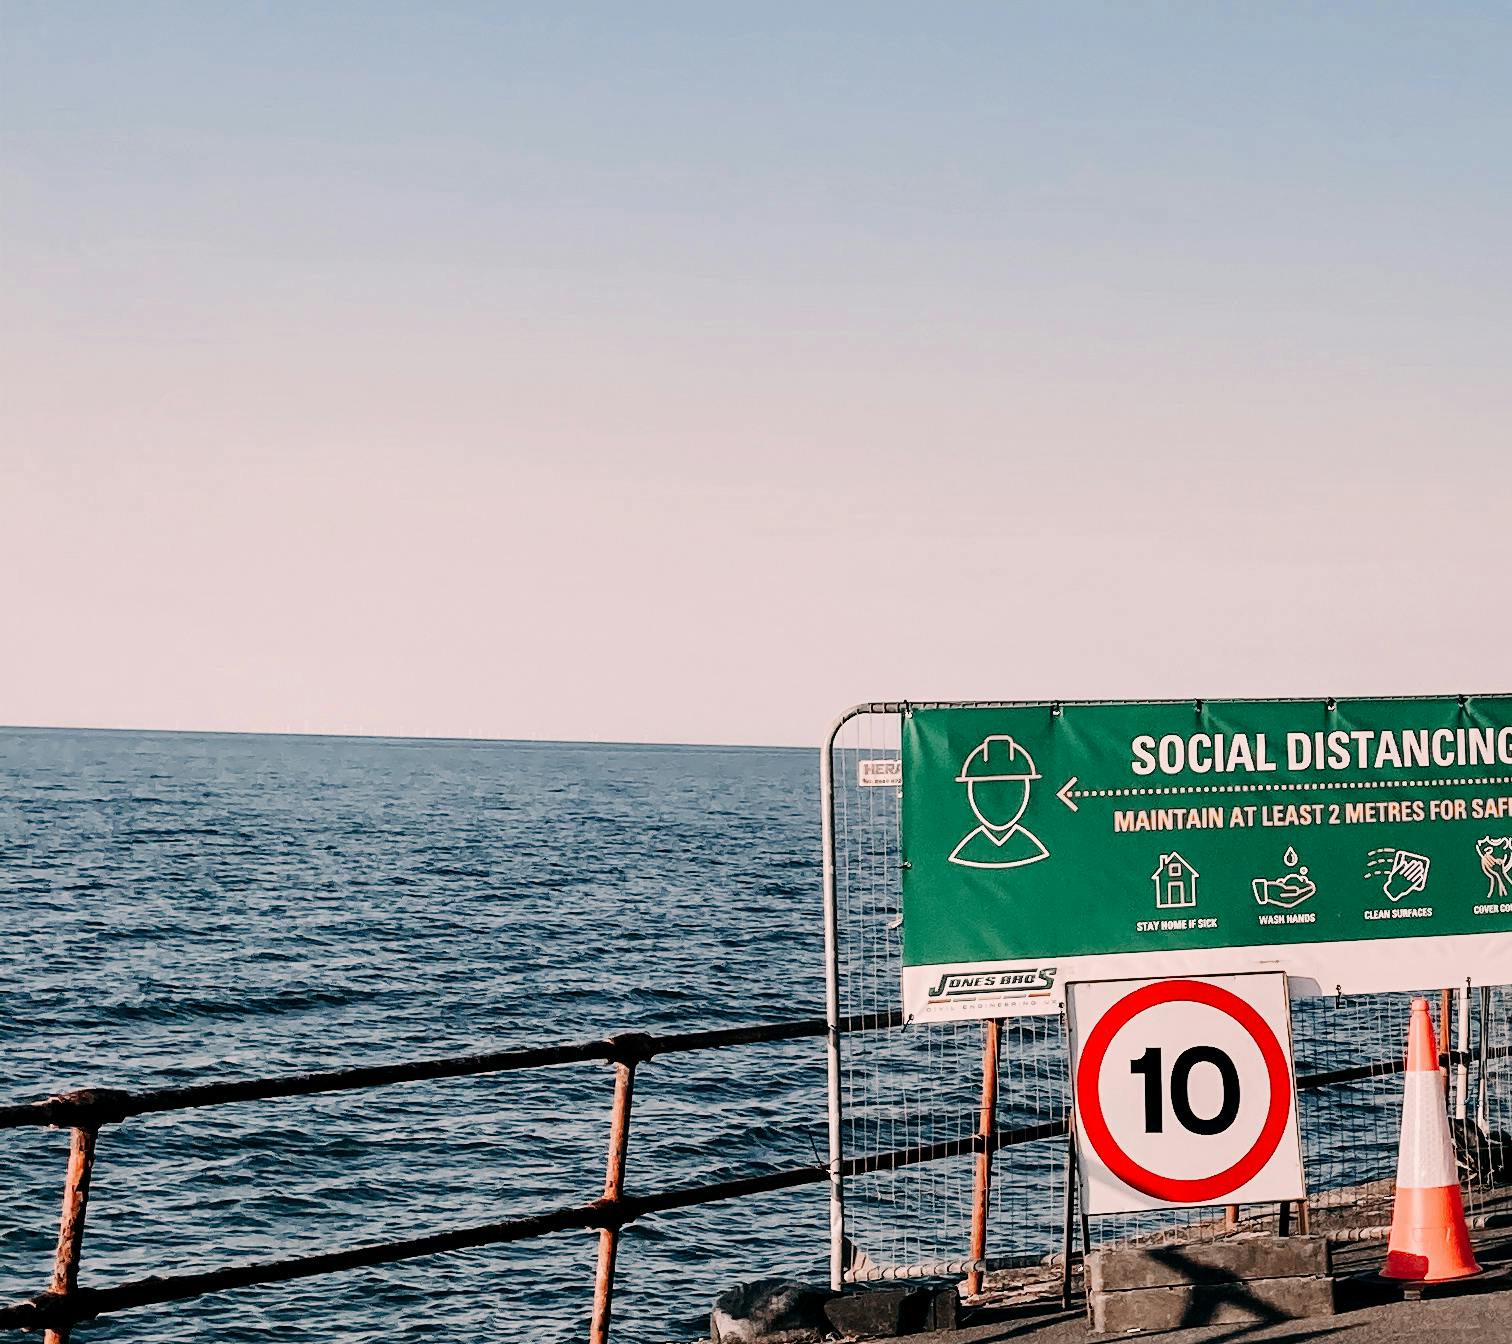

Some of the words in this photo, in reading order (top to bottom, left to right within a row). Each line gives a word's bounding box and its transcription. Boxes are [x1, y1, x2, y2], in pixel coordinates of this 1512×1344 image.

[1131, 733, 1276, 776] SOCIAL
[1114, 807, 1224, 832] MAINTAIN
[1230, 805, 1257, 828] AT
[1262, 804, 1325, 827] LEAST
[1328, 804, 1340, 824] 2
[1346, 801, 1425, 824] METRES
[1429, 799, 1467, 821] FOR
[1259, 914, 1285, 925] WASH
[1286, 913, 1316, 924] HANDS
[1364, 909, 1390, 920] CLEAN
[1391, 907, 1433, 919] SURFACES
[1474, 904, 1499, 915] COVER
[1136, 921, 1160, 932] STAY
[1161, 919, 1187, 931] HOME
[1189, 919, 1197, 929] IF
[1197, 918, 1218, 929] SICK
[928, 974, 996, 997] JONES
[1000, 968, 1057, 990] BROS
[1130, 1045, 1241, 1136] 10
